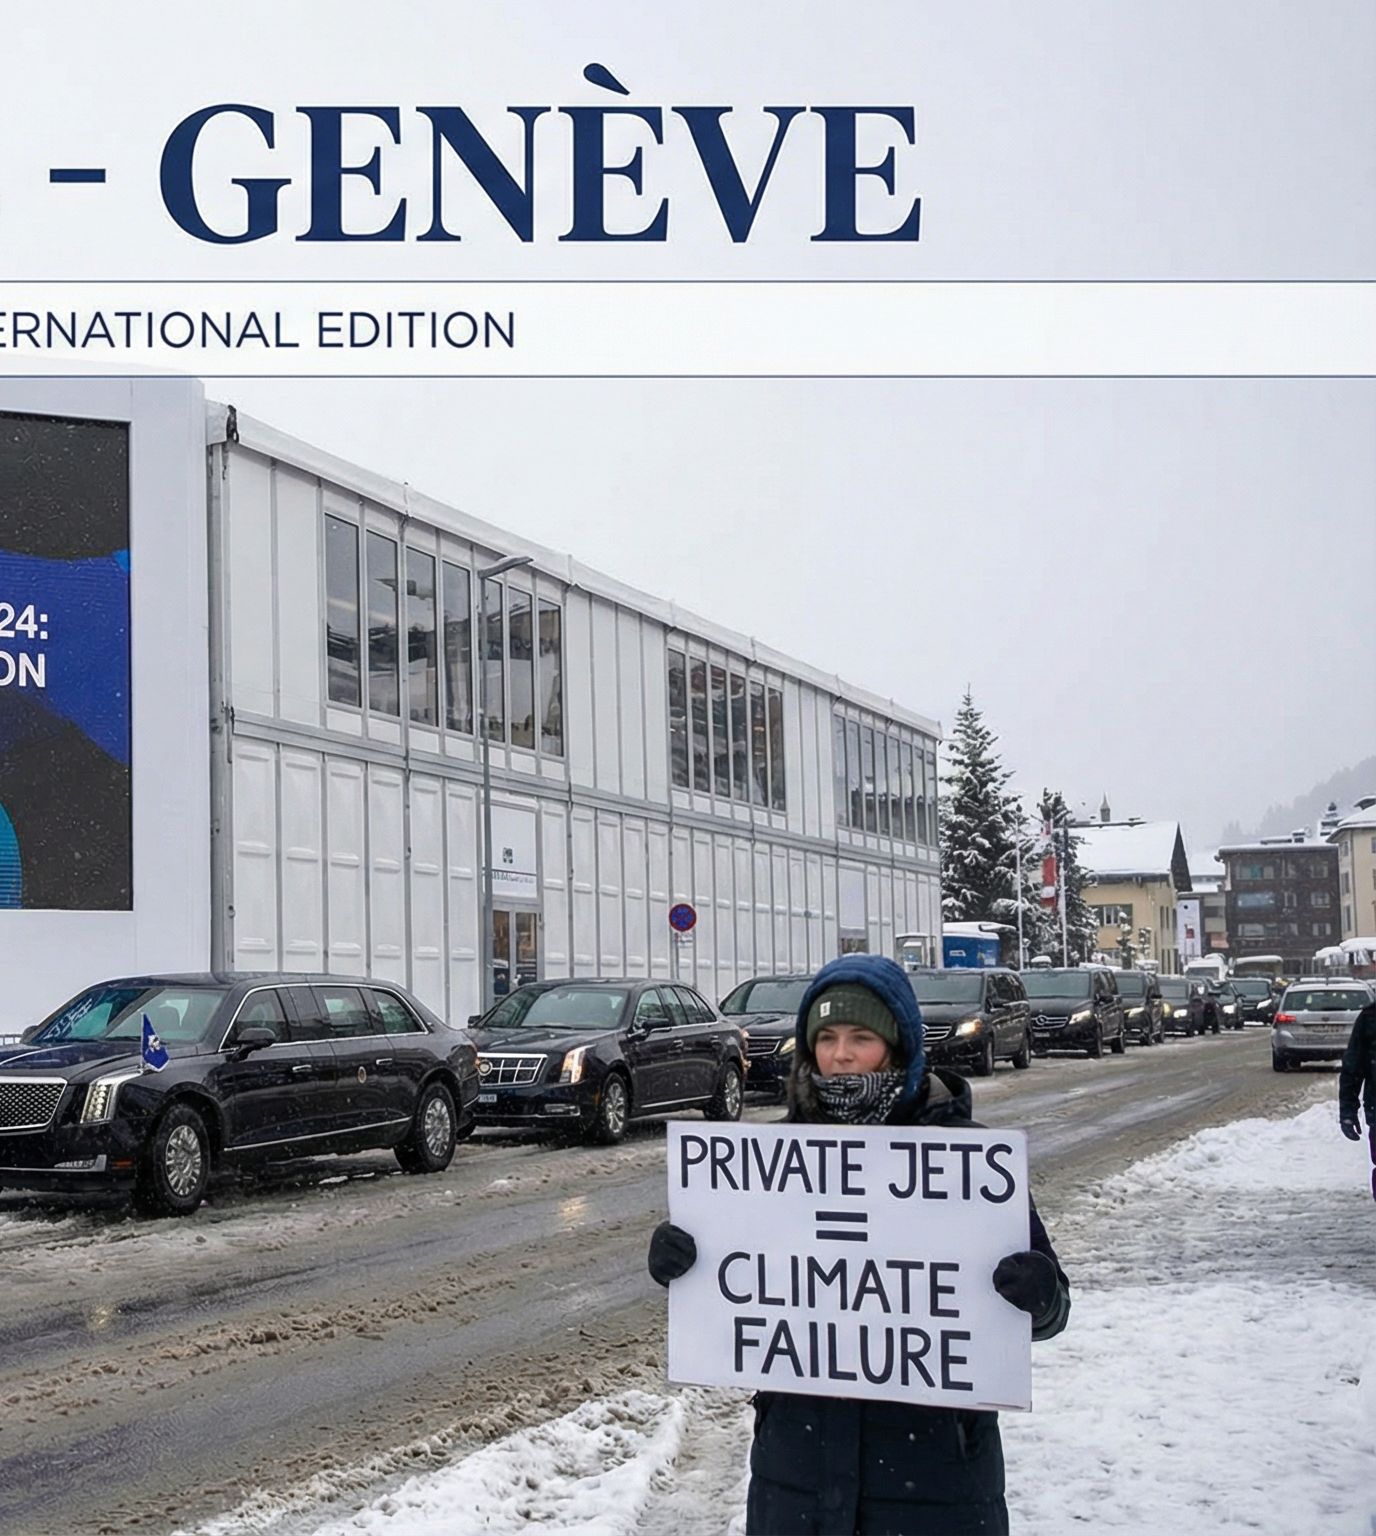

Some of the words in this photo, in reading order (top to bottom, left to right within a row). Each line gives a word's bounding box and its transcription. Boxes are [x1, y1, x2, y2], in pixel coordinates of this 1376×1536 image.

[681, 1135, 865, 1195] PRIVATE
[889, 1142, 1015, 1203] JETS
[718, 1252, 960, 1319] CLIMATE
[733, 1316, 974, 1392] FAILURE
